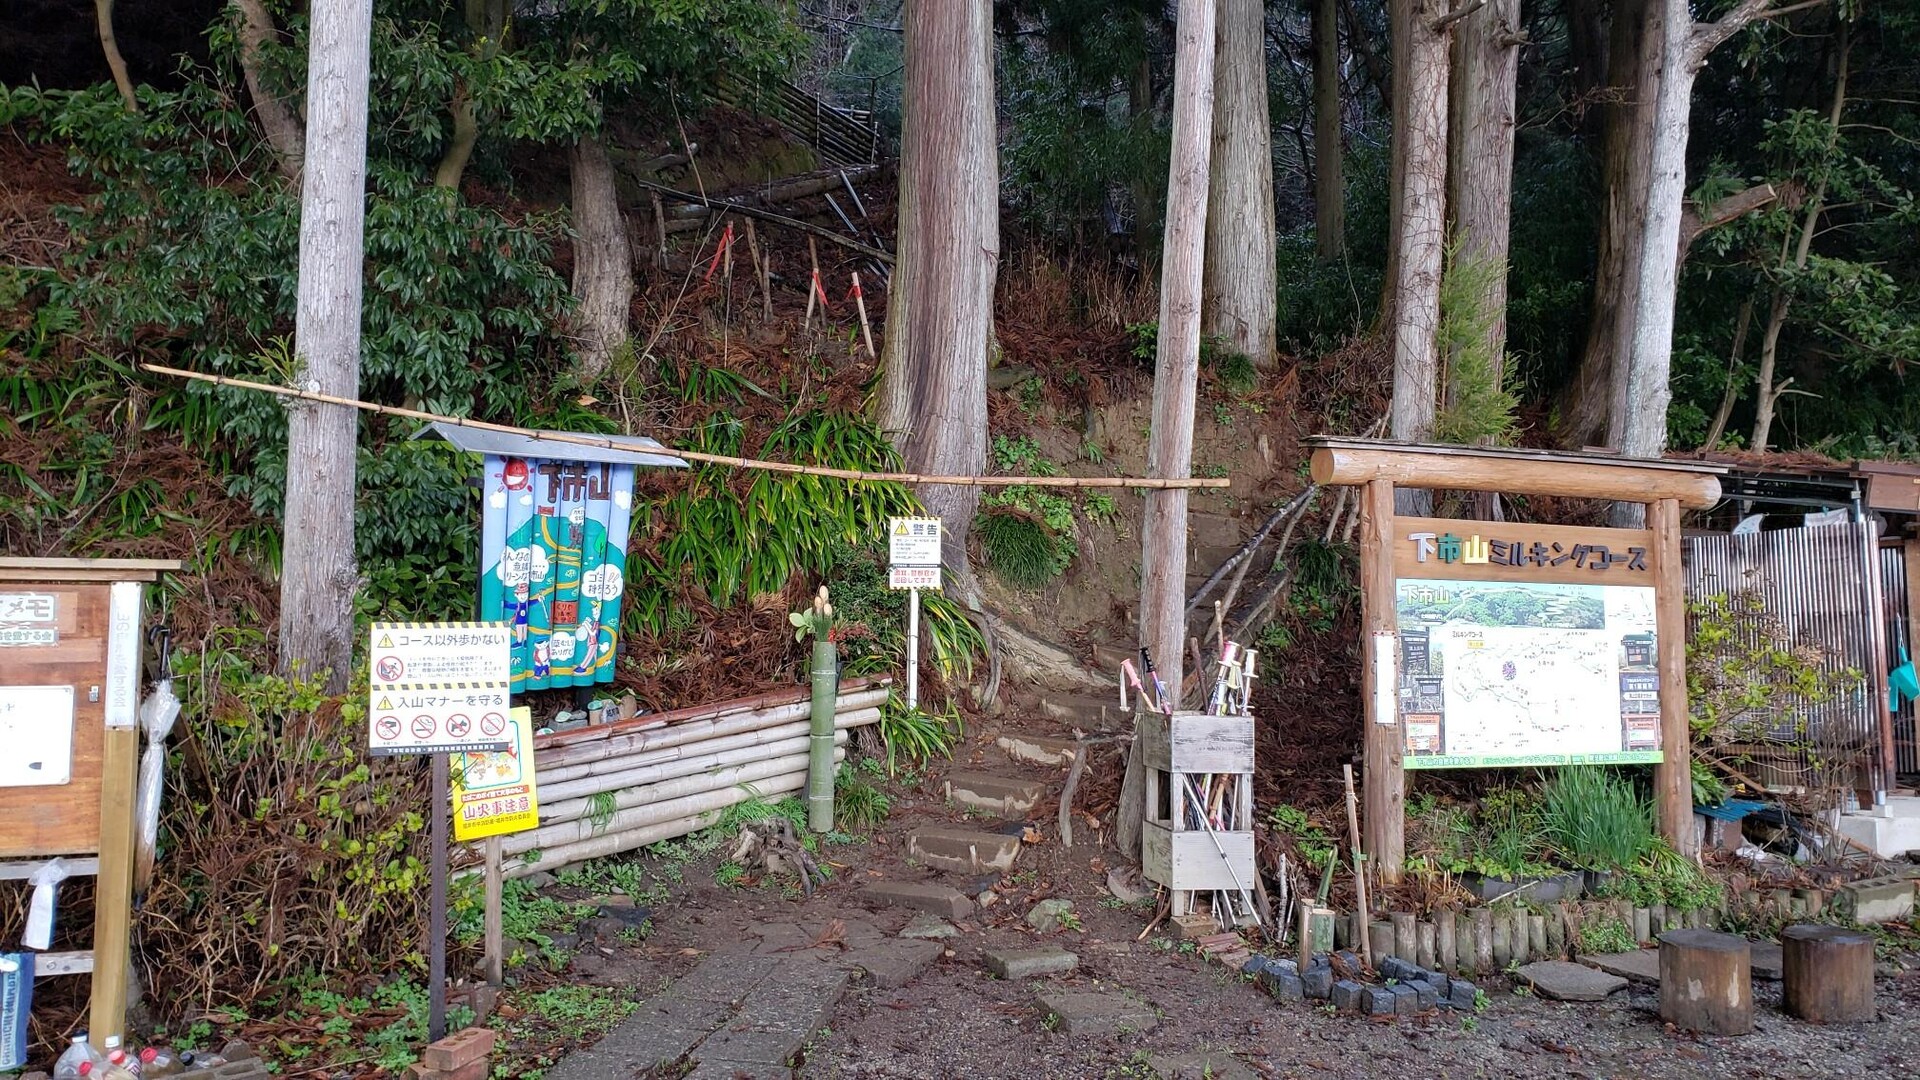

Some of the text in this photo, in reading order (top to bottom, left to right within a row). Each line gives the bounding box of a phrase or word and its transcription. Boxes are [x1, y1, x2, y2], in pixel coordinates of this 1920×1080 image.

[537, 460, 610, 503] 下市山
[1408, 532, 1648, 571] 下市山ミルキングコース
[1401, 584, 1450, 606] 下市山
[398, 633, 506, 648] コース以外歩かない
[397, 694, 504, 709] 入山マナーを守る
[463, 797, 529, 820] 山火事注意
